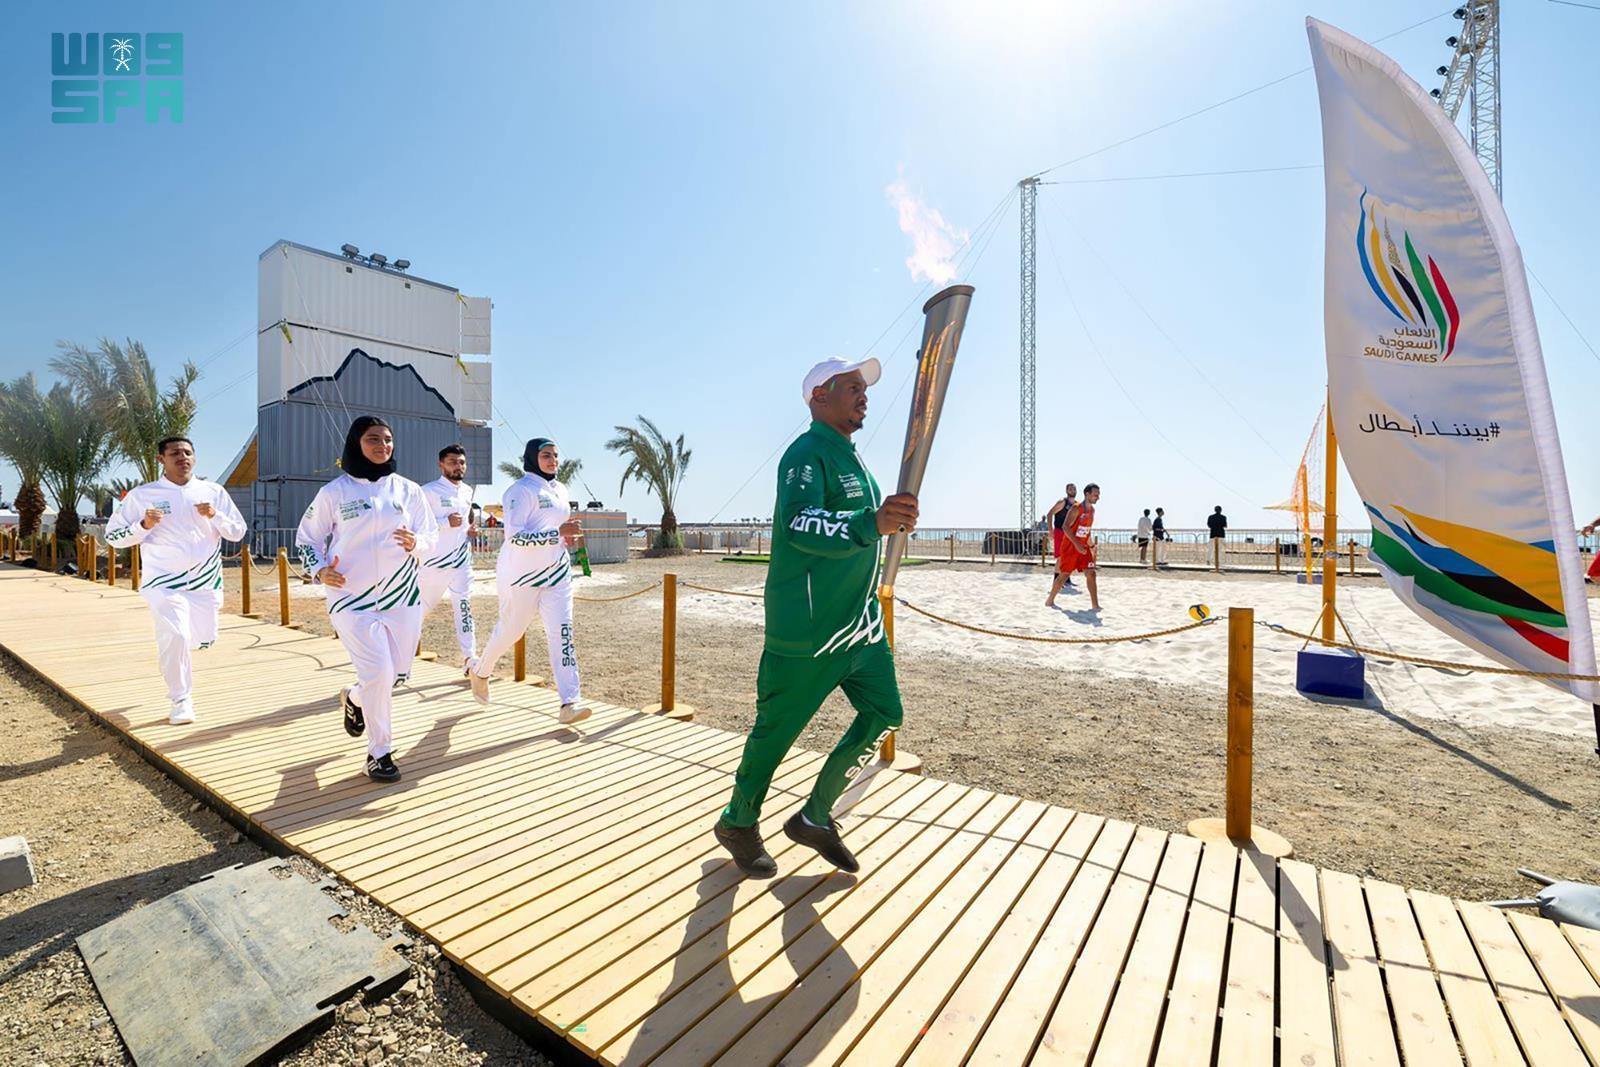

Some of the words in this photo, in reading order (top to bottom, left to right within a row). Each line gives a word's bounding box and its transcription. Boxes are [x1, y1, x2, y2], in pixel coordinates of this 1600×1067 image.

[1378, 335, 1438, 350] السعودية
[1363, 346, 1395, 359] SAUDI
[1395, 351, 1438, 363] GAMES
[789, 515, 850, 540] SAUDI
[510, 538, 560, 547] SAUDI
[460, 598, 470, 633] SAUDI
[560, 623, 571, 667] SAUDI
